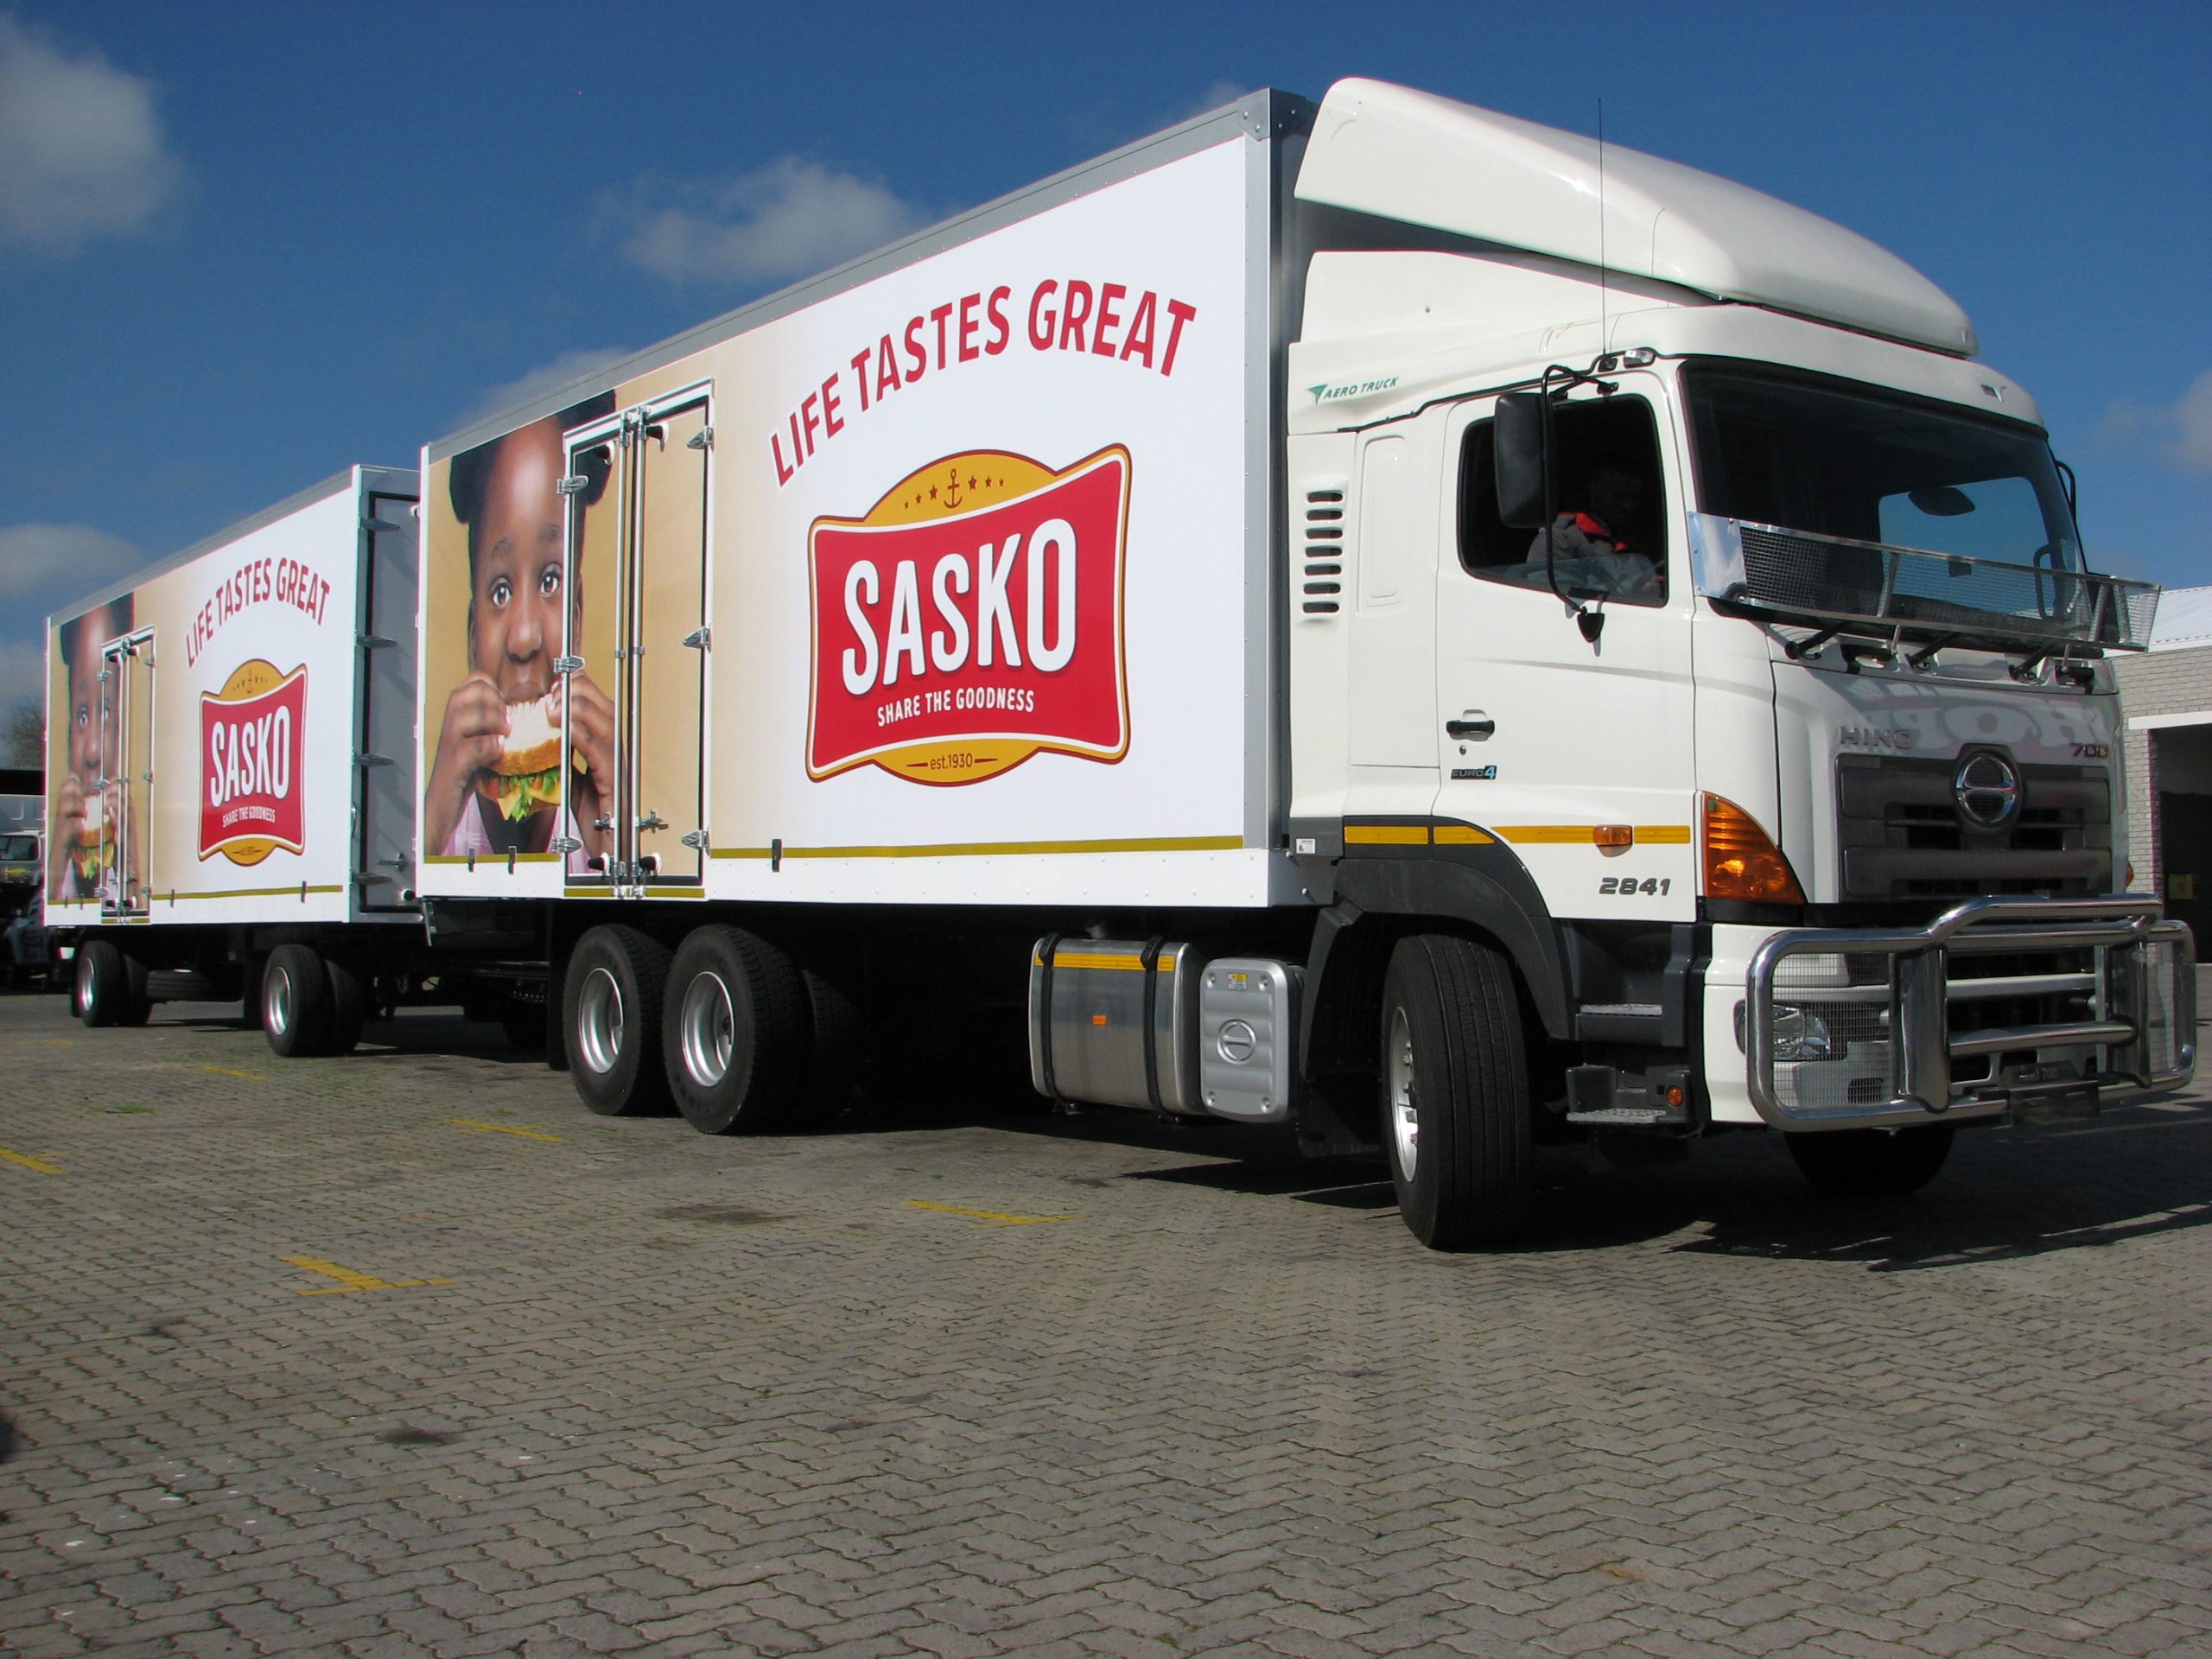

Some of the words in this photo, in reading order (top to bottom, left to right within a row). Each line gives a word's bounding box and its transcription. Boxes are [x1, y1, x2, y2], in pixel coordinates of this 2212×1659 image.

[770, 372, 845, 487] LIFE
[851, 285, 1012, 413] TASTES
[1027, 278, 1198, 378] GREAT
[1323, 385, 1358, 399] AERO
[1360, 376, 1400, 394] TRUCK
[186, 598, 214, 669] LIFE
[216, 557, 272, 626] TASTES
[276, 557, 331, 626] GREAT
[842, 518, 1077, 696] SASKO
[877, 695, 921, 728] SHARE
[925, 689, 951, 714] THE
[956, 687, 1035, 713] GOODNESS
[1839, 727, 1916, 750] HINO
[2069, 742, 2110, 759] 700
[210, 705, 291, 808] SASKO
[222, 809, 238, 829] SHARE
[238, 806, 249, 821] THE
[249, 805, 276, 823] GOODNESS
[1599, 877, 1671, 896] 2841
